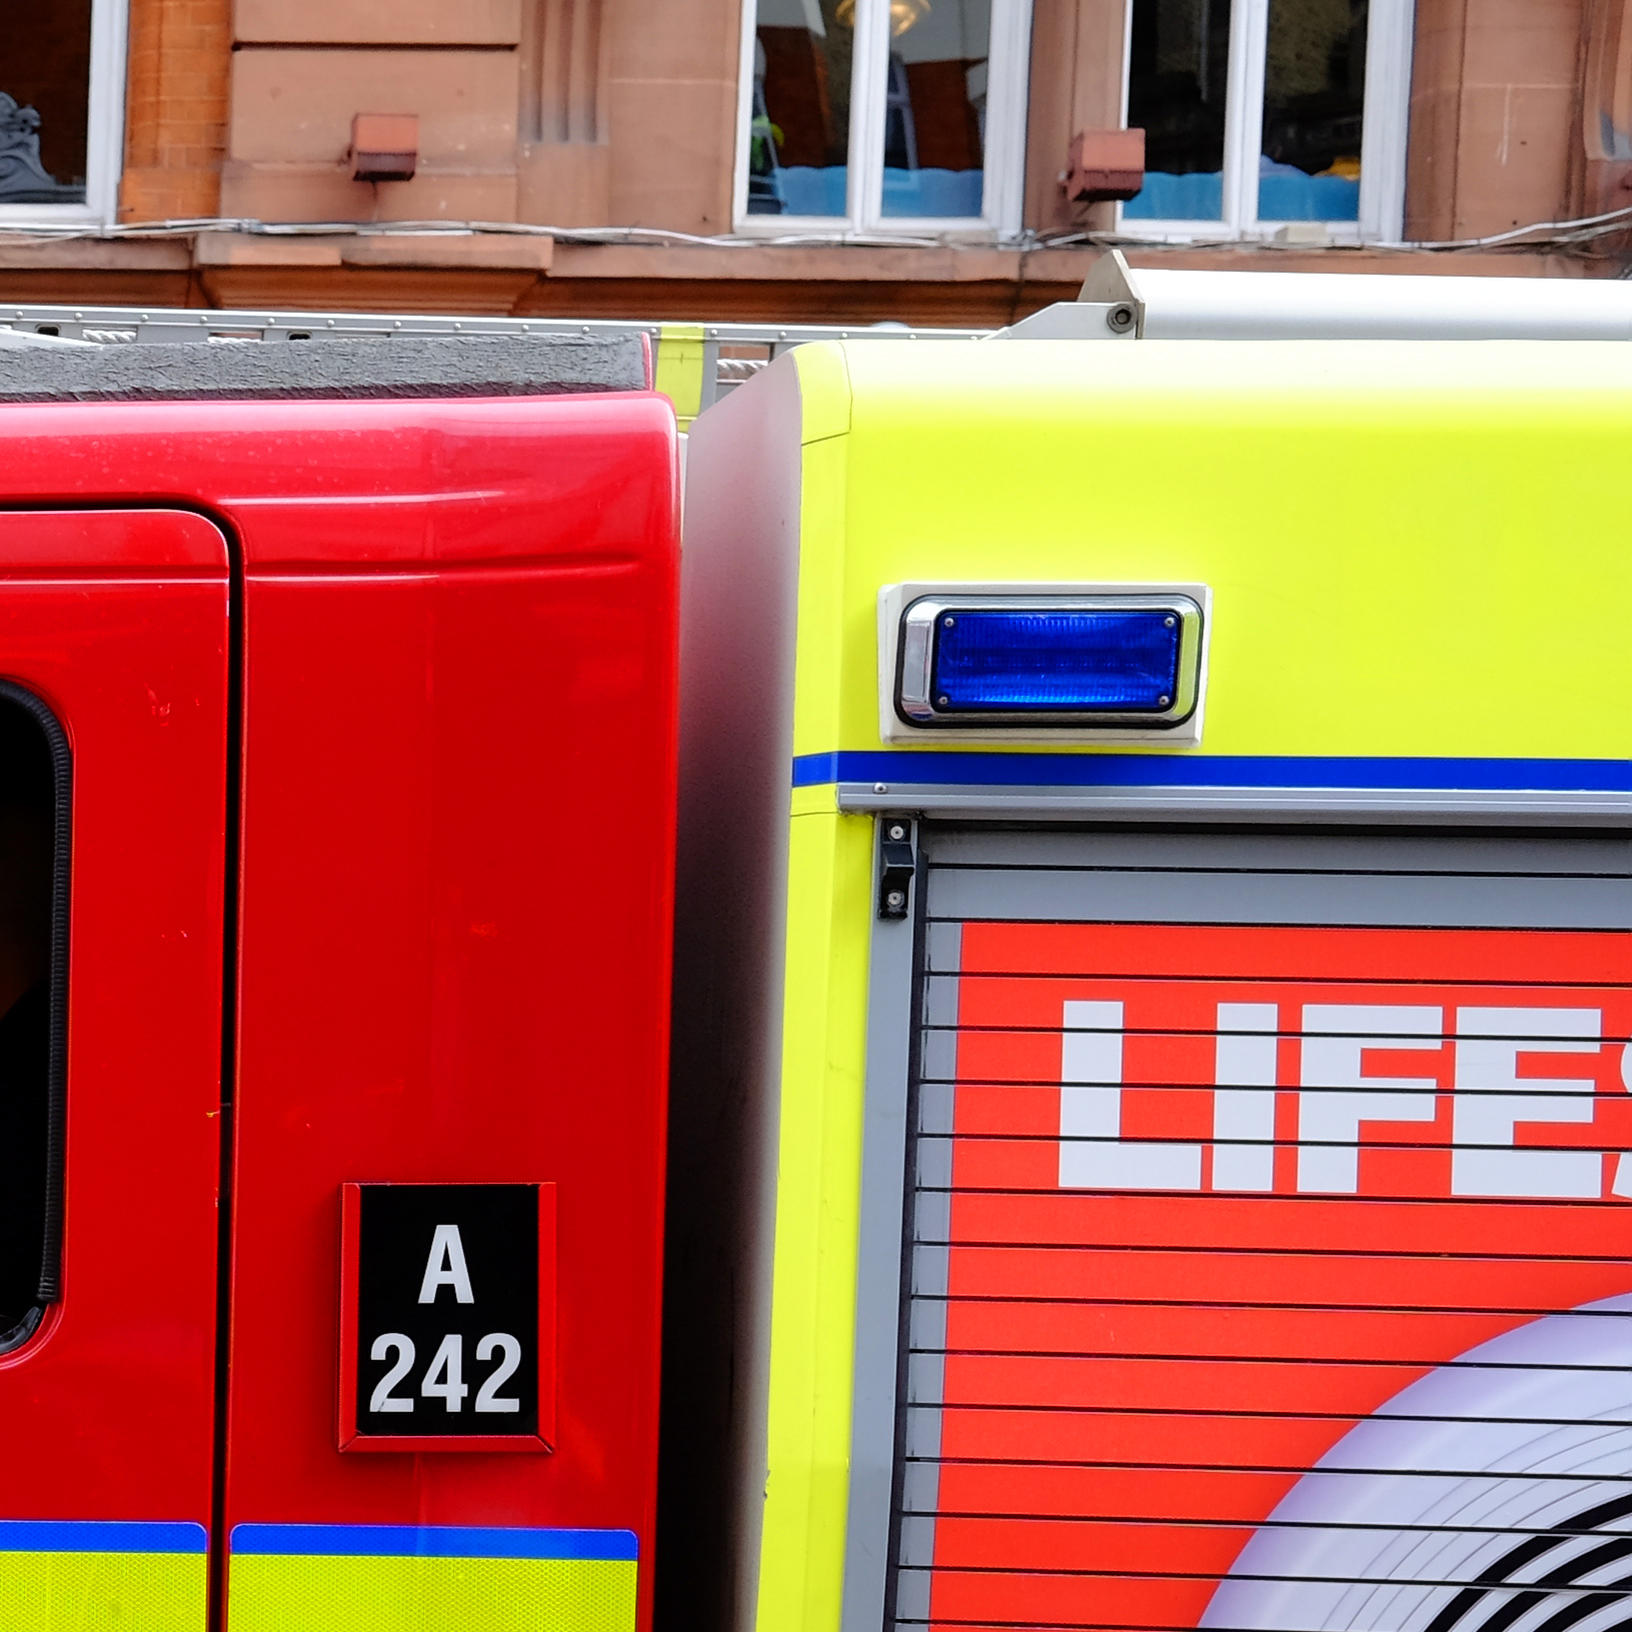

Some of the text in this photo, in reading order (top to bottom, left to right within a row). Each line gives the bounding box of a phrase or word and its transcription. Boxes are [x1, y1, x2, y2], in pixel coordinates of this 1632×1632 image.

[1058, 1000, 1632, 1198] LIFE
[418, 1224, 475, 1304] A
[369, 1332, 522, 1413] 242
